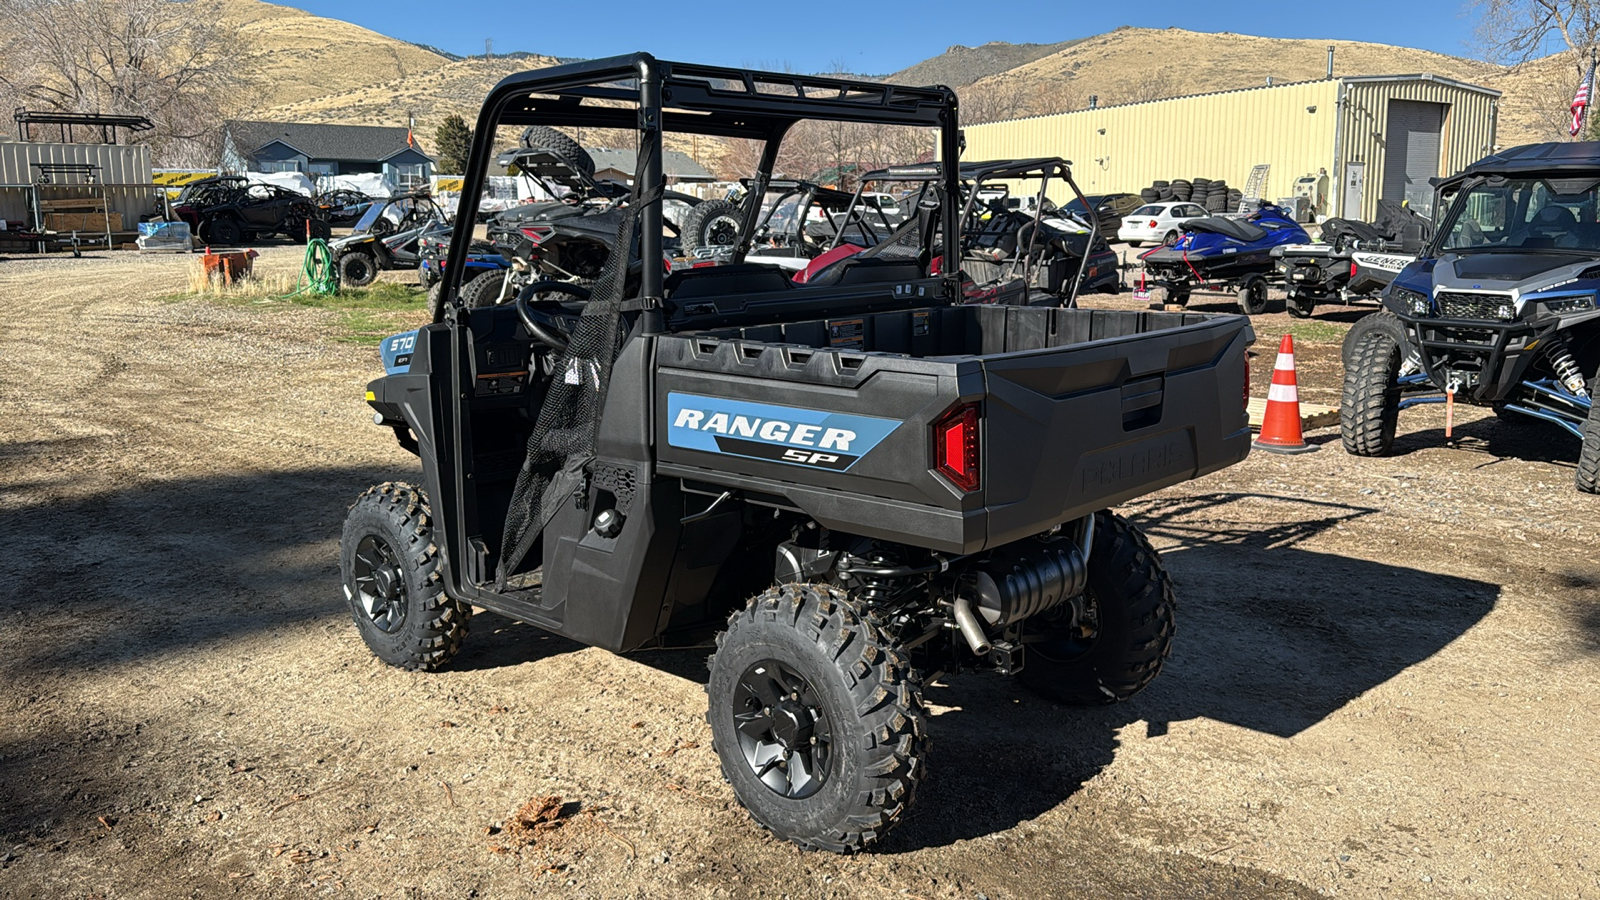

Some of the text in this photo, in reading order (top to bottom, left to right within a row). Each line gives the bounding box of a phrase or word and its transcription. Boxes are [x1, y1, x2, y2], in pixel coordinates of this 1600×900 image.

[1364, 255, 1410, 266] GENER
[1537, 277, 1579, 293] 1000
[390, 336, 415, 352] 570
[673, 408, 857, 451] RANGER
[781, 448, 840, 464] SP
[1081, 442, 1183, 493] POLARIS
